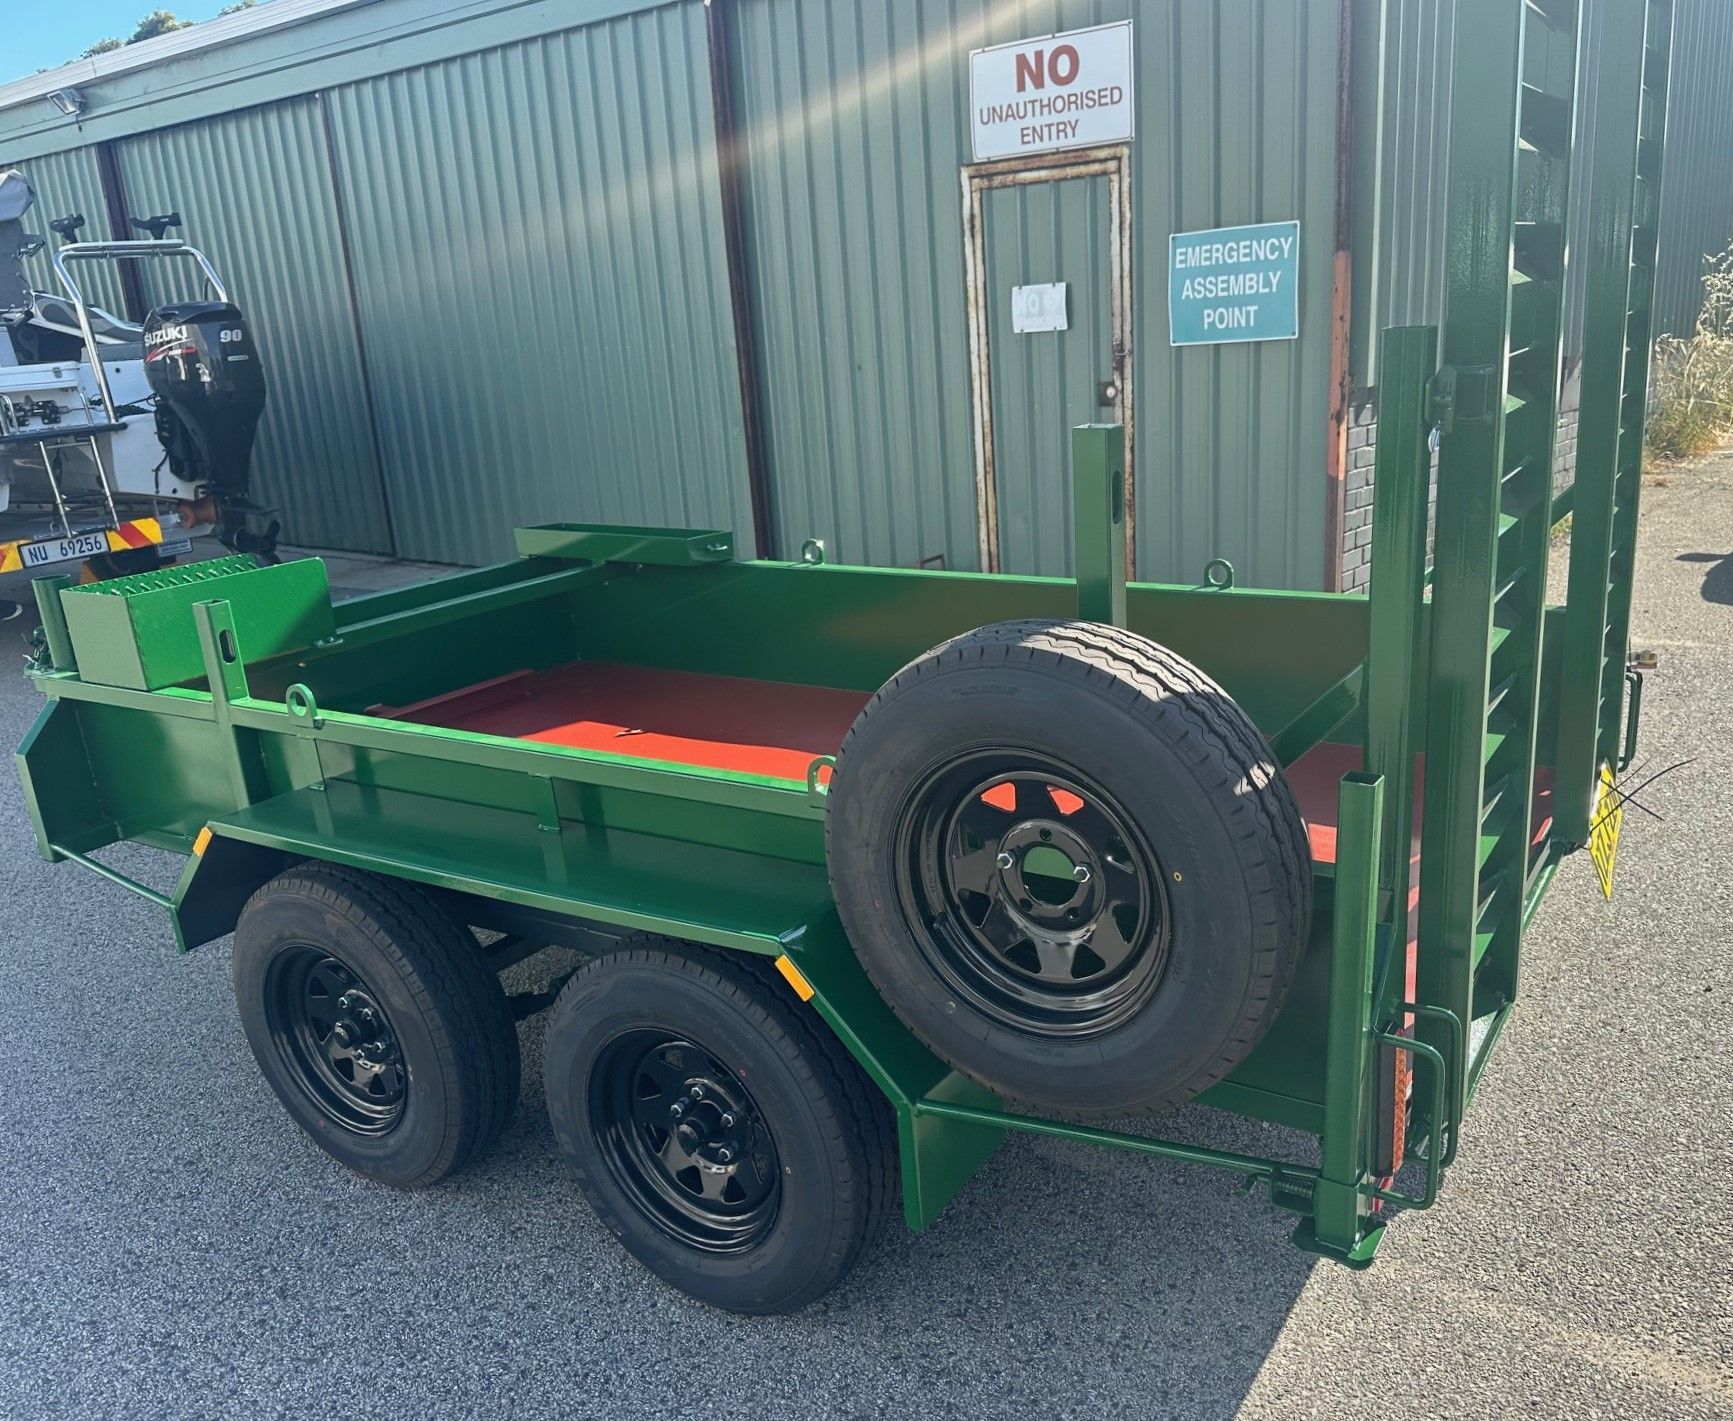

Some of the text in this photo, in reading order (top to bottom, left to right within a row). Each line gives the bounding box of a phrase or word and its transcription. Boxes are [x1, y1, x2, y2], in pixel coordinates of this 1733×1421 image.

[1015, 44, 1080, 93] NO
[979, 85, 1123, 126] UNAUTHORISED
[1020, 119, 1080, 145] ENTRY
[1175, 236, 1293, 269] EMERGENCY
[1181, 271, 1281, 300] ASSEMBLY
[1203, 305, 1259, 330] POINT
[144, 325, 188, 347] SUZUKI
[220, 329, 242, 343] 90
[27, 535, 102, 563] NU 69256
